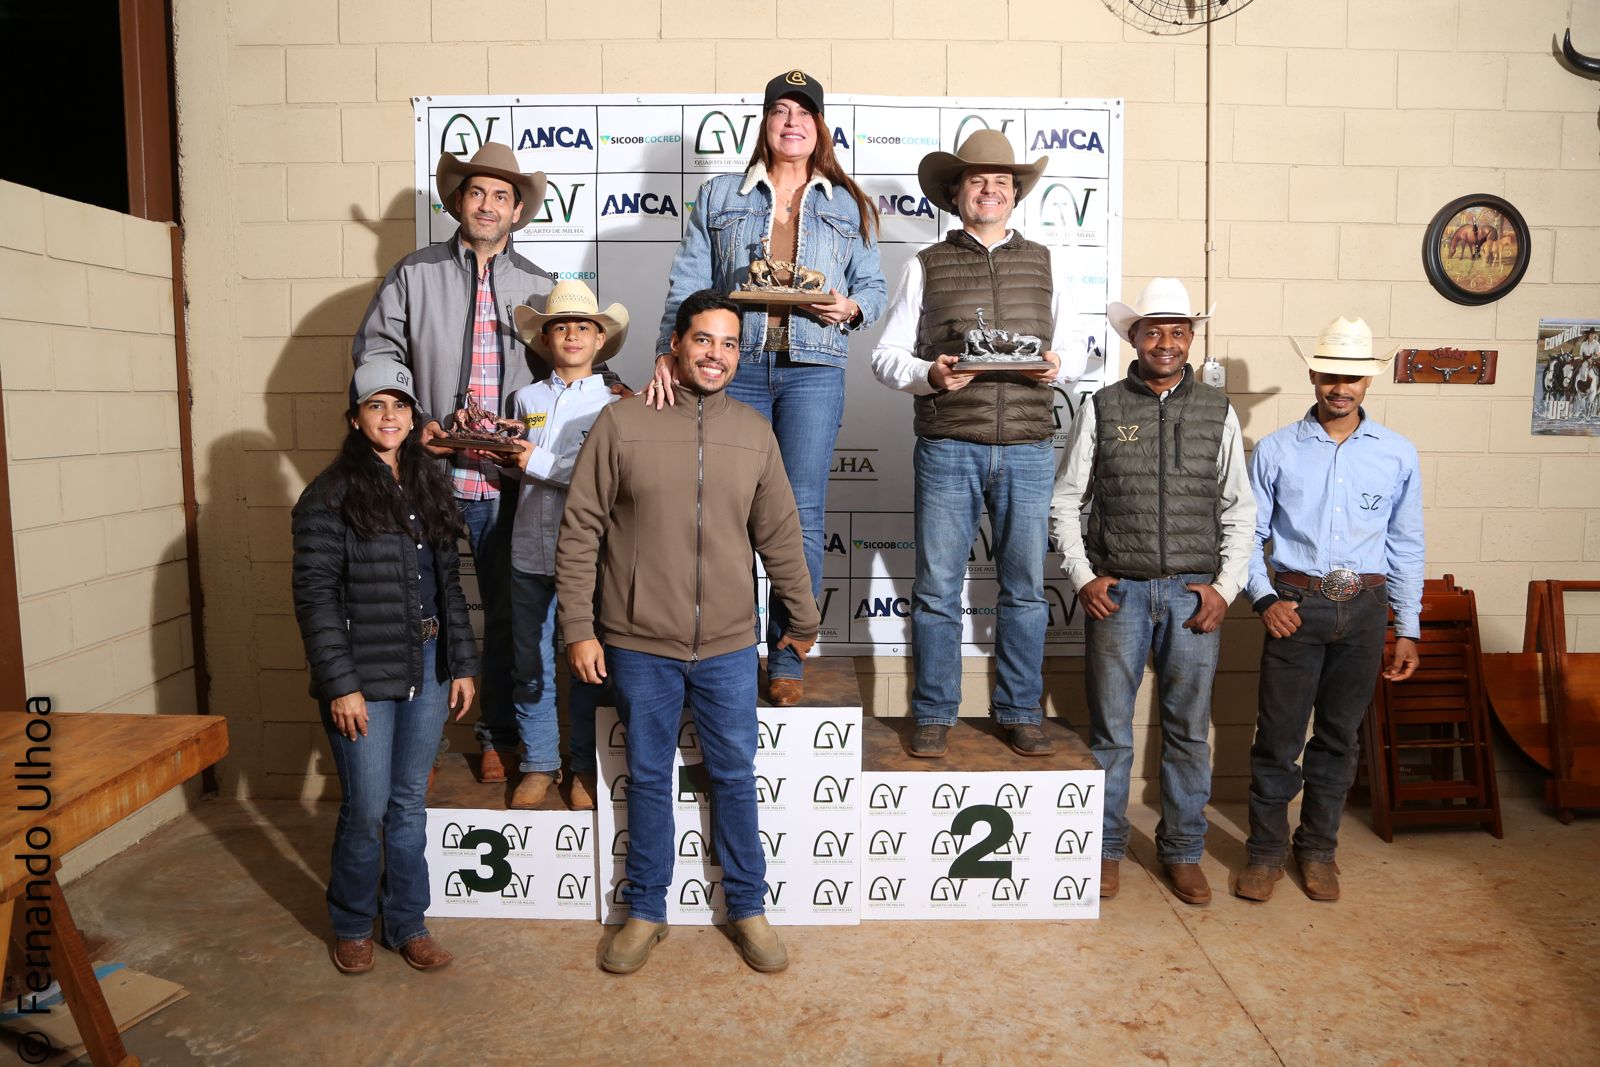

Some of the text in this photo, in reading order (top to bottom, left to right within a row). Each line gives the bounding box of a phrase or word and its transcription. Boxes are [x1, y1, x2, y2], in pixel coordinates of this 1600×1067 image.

[518, 126, 593, 151] ANCA
[1030, 128, 1105, 154] ANCA
[601, 192, 679, 217] ANCA
[878, 194, 935, 219] NCA
[1544, 325, 1582, 350] COWGIRL
[863, 540, 916, 550] SICOOBCOC
[853, 597, 911, 620] ANC
[948, 804, 1014, 879] 2
[459, 828, 513, 893] 3
